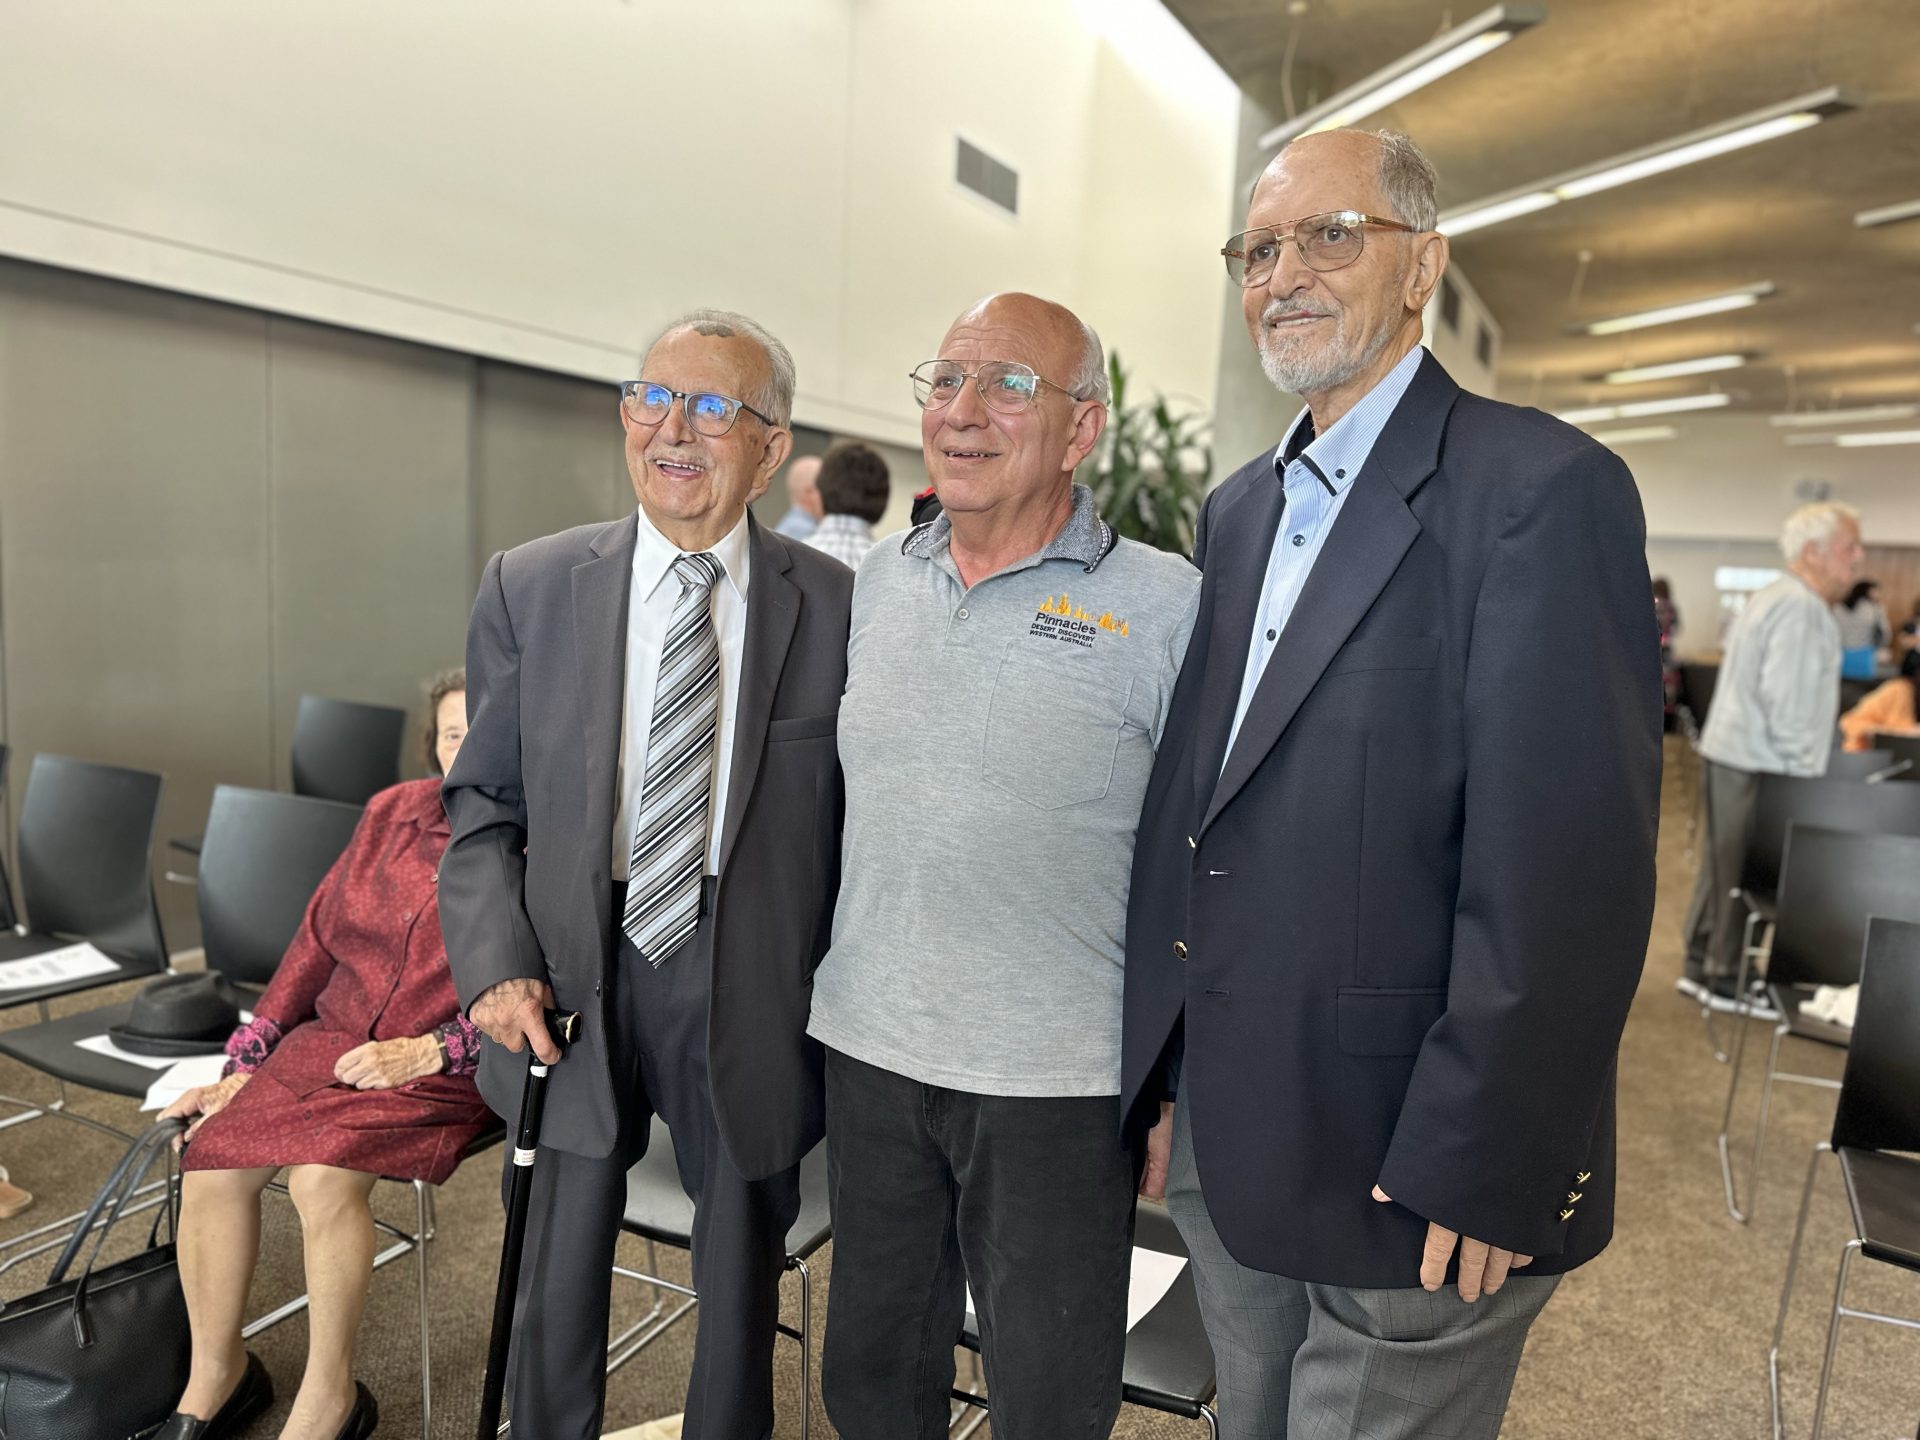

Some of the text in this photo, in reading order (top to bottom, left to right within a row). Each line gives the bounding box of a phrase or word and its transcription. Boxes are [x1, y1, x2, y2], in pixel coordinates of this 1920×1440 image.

[1031, 623, 1095, 642] DESERT DISCOVERY
[1035, 612, 1097, 635] Pinnacles
[1029, 630, 1093, 648] WESTERN AUSTRALIA
